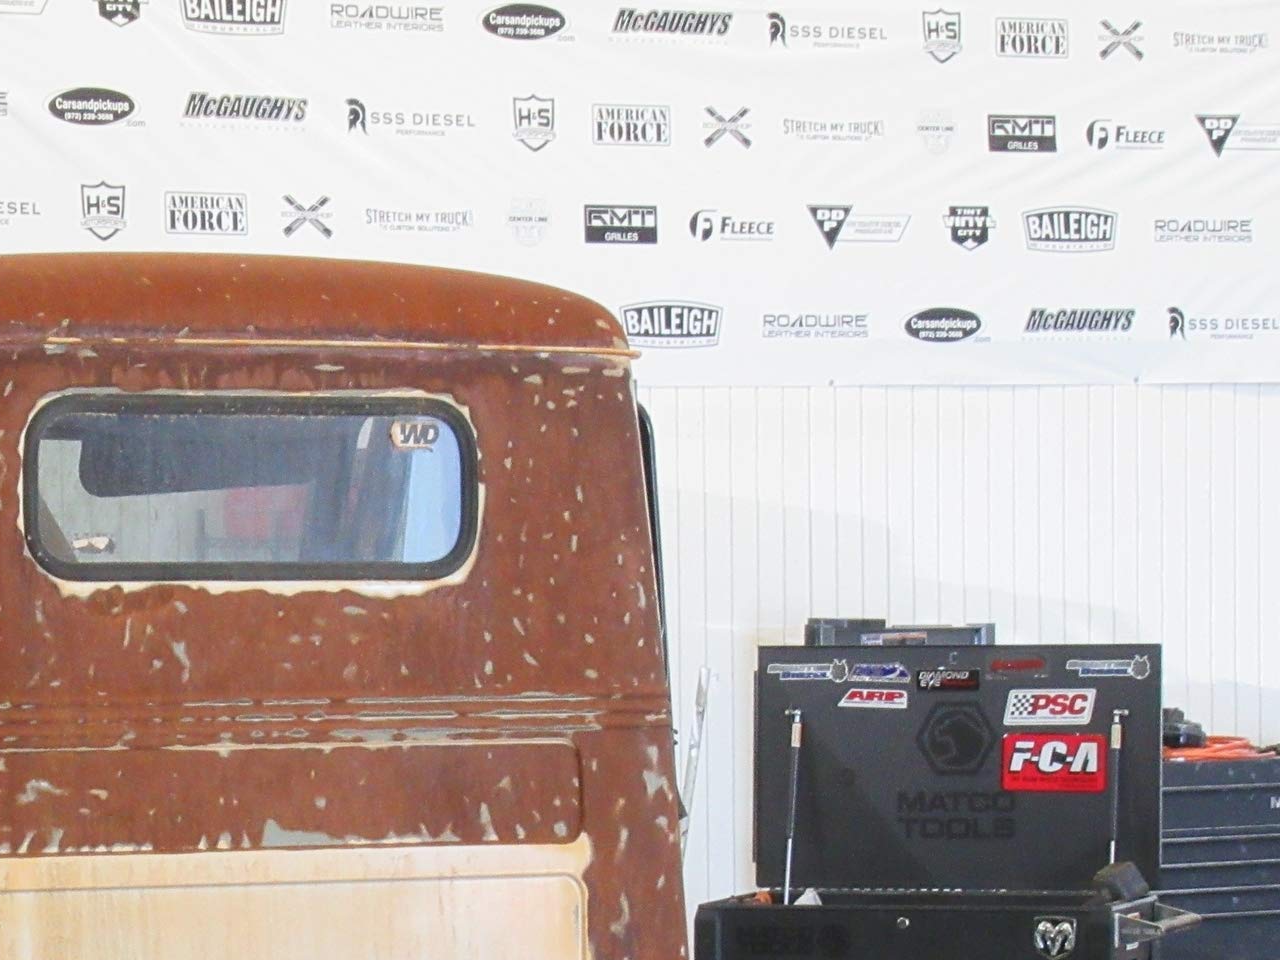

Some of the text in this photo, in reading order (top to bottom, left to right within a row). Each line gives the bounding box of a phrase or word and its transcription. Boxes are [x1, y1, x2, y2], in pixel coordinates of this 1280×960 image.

[330, 4, 443, 21] ROADWIRE
[489, 13, 561, 27] Carsandpickups
[330, 20, 444, 32] LEATHER INTERIORS
[611, 8, 733, 36] McGAUGHYS
[1000, 20, 1065, 35] AMERICAN
[789, 25, 888, 40] SSS DIESEL
[1173, 31, 1263, 48] STRETCH MY TRUCK
[1000, 34, 1065, 55] FORCE
[55, 97, 129, 112] Carsandpickups
[183, 91, 307, 120] McGAUGHYS
[370, 111, 476, 127] SSS DIESEL
[596, 107, 668, 121] AMERICAN
[596, 120, 668, 143] FORCE
[783, 118, 880, 135] STRETCH MY TRUCK
[1115, 126, 1165, 144] FLEECE
[1007, 141, 1038, 151] GRILLES
[168, 195, 243, 210] AMERICAN
[168, 209, 245, 232] FORCE
[365, 208, 469, 226] STRETCH MY TRUCK
[720, 216, 775, 235] FLEECE
[957, 229, 981, 237] CITY
[1028, 213, 1112, 240] BAILEIGH
[1154, 219, 1253, 233] ROADWIRE
[604, 232, 639, 242] GRILLES
[1154, 234, 1253, 243] LEATHER INTERIORS
[626, 306, 716, 336] BAILEIGH
[762, 313, 870, 328] ROADWIRE
[910, 317, 977, 330] Carsandpickups
[1024, 308, 1135, 333] McGAUGHYS
[1188, 318, 1279, 331] SSS DIESEL
[762, 329, 869, 338] LEATHER INTERIORS
[918, 670, 969, 679] DIAMOND
[845, 690, 904, 701] ARP
[1030, 693, 1089, 716] PSC
